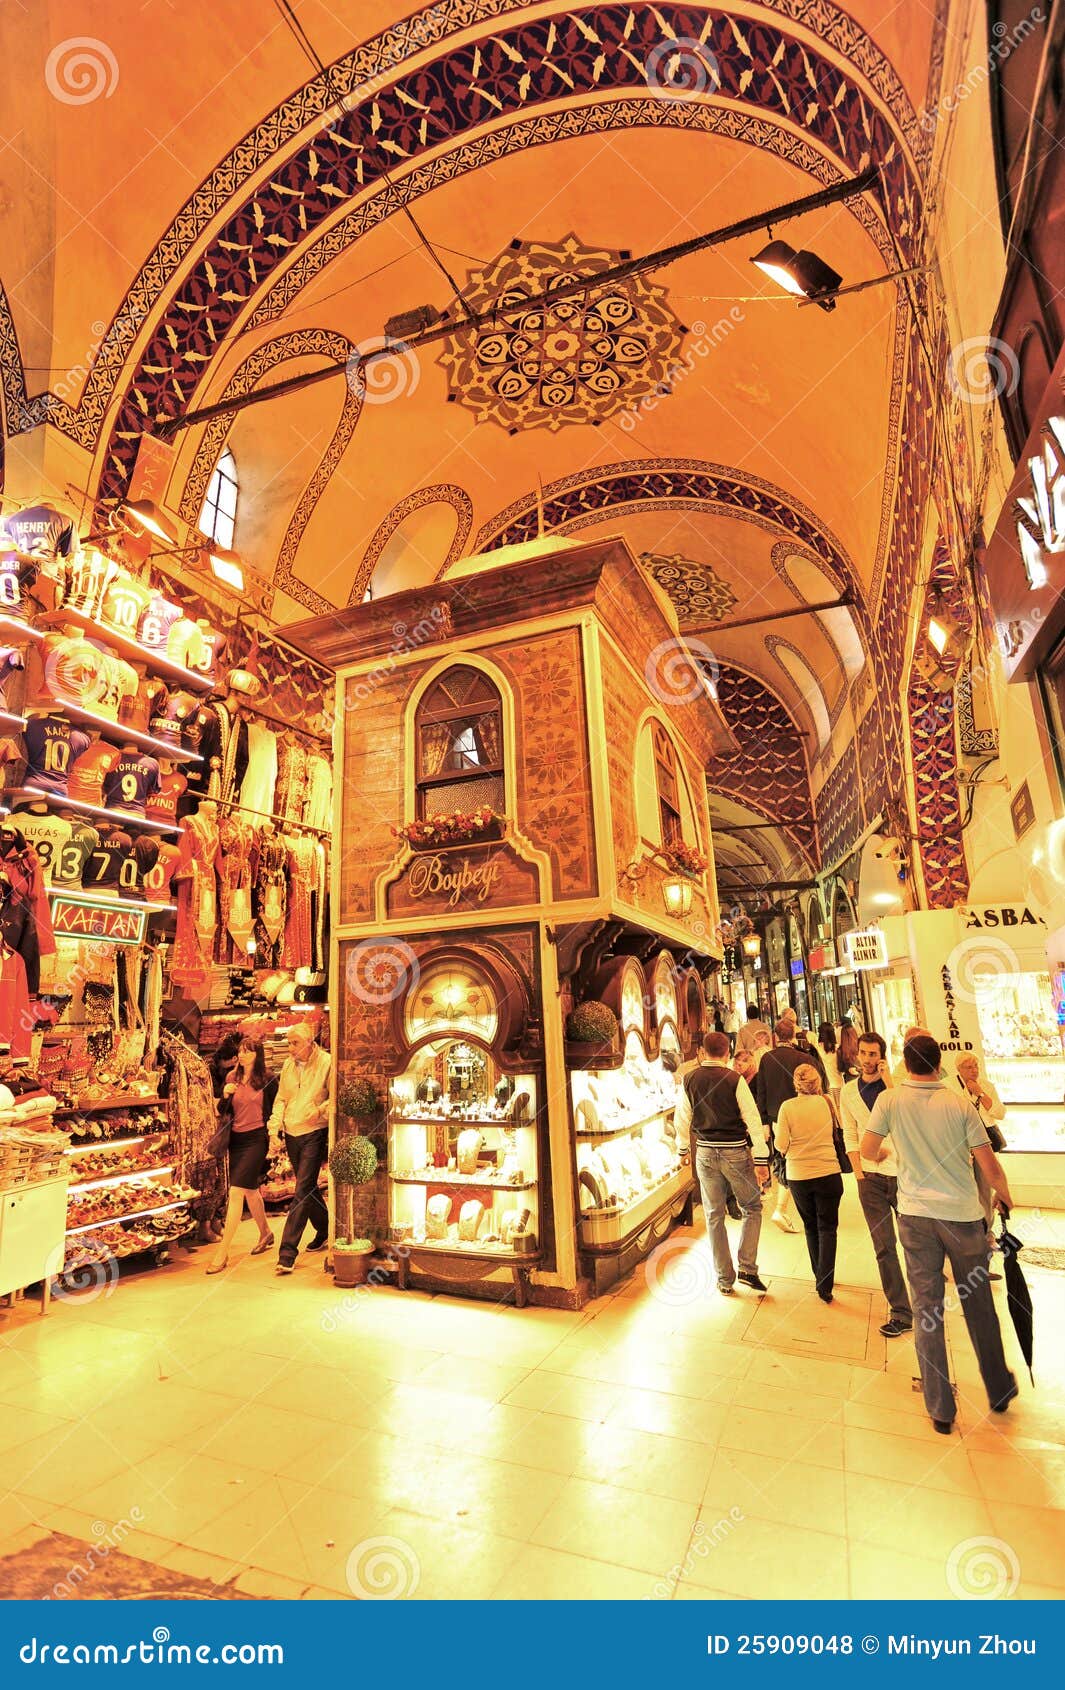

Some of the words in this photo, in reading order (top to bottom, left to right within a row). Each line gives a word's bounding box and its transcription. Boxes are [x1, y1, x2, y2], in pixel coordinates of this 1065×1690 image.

[16, 521, 51, 533] HENRY
[114, 598, 137, 626] 10
[44, 739, 71, 772] 10
[121, 774, 138, 802] 9
[146, 797, 175, 810] WIND
[24, 827, 59, 837] LUCAS
[93, 852, 111, 881] 7
[409, 853, 501, 906] Boybeyi
[56, 903, 141, 938] KAFTAN
[856, 935, 877, 948] ALTIN
[940, 1042, 973, 1051] GOLD
